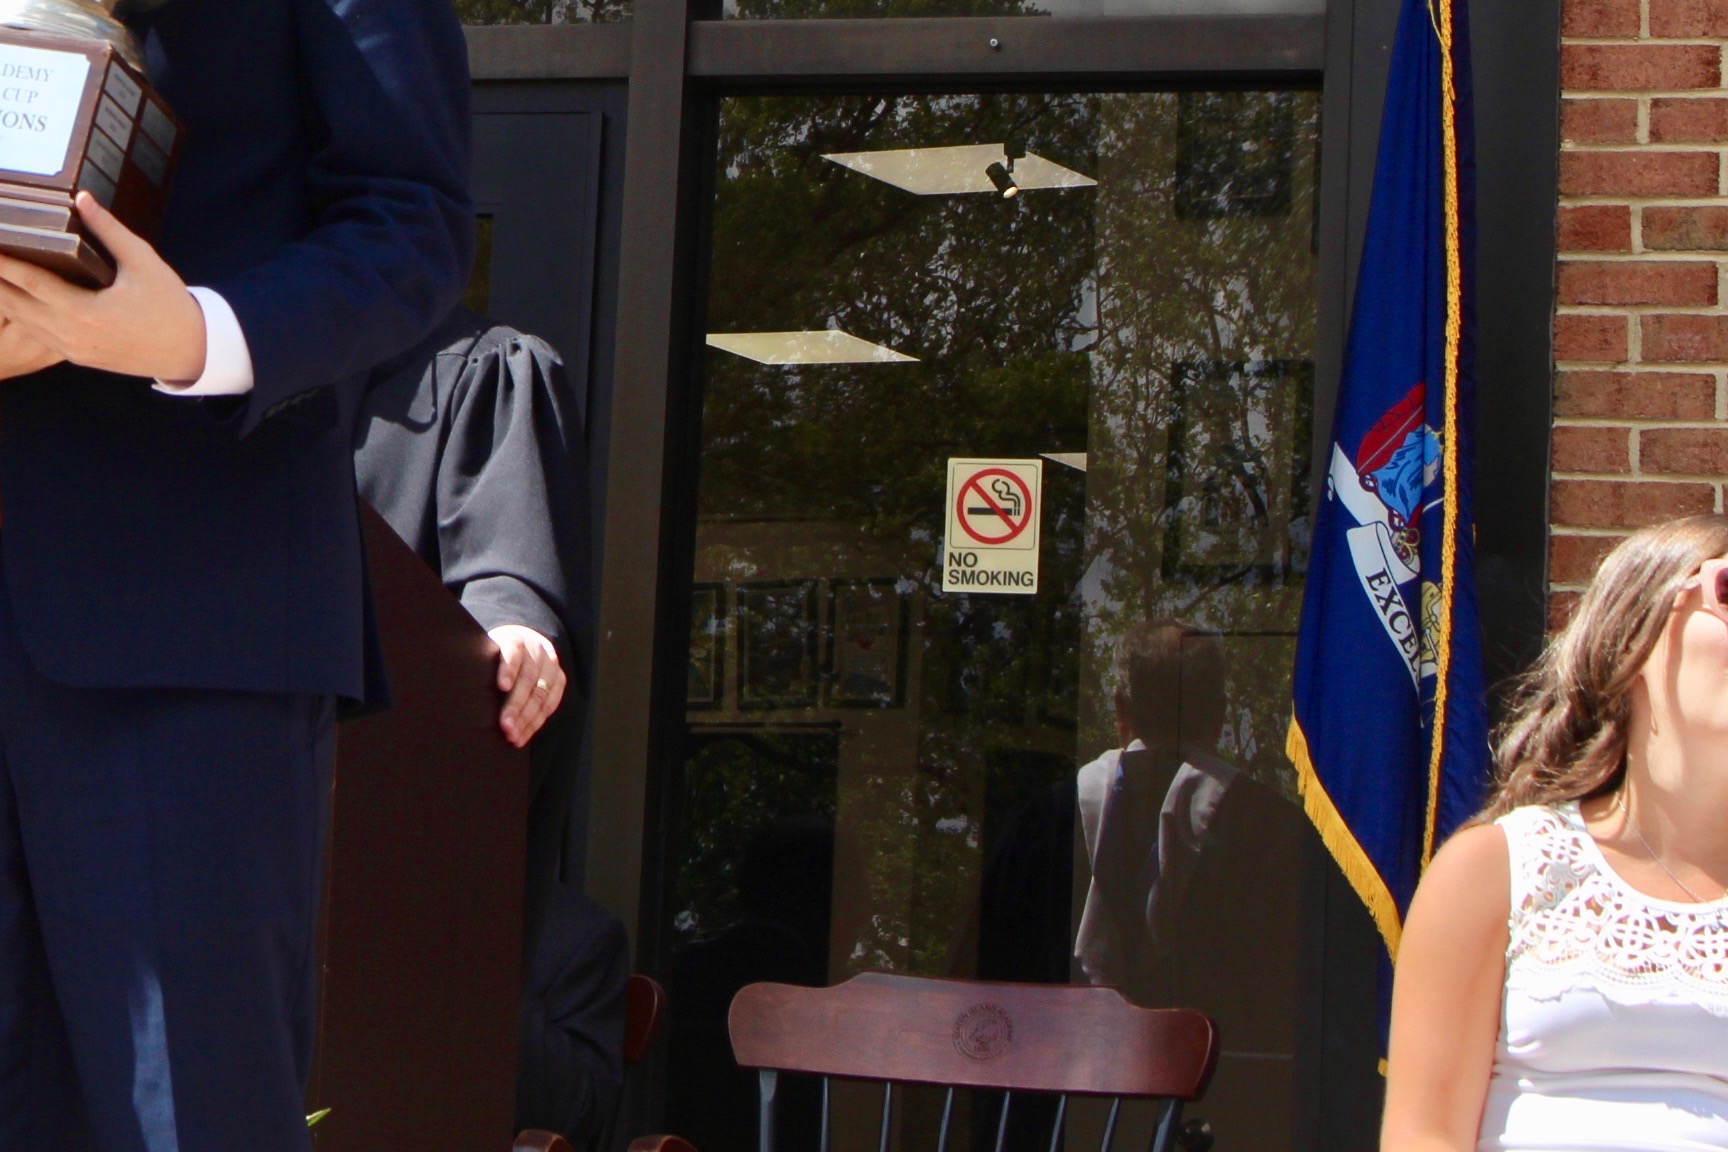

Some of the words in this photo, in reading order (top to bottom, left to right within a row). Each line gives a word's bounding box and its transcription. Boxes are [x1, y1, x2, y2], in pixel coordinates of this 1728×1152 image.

[2, 86, 39, 104] CUP
[948, 552, 978, 568] NO
[948, 569, 1034, 587] SMOKING
[1365, 567, 1421, 686] EXCEL
